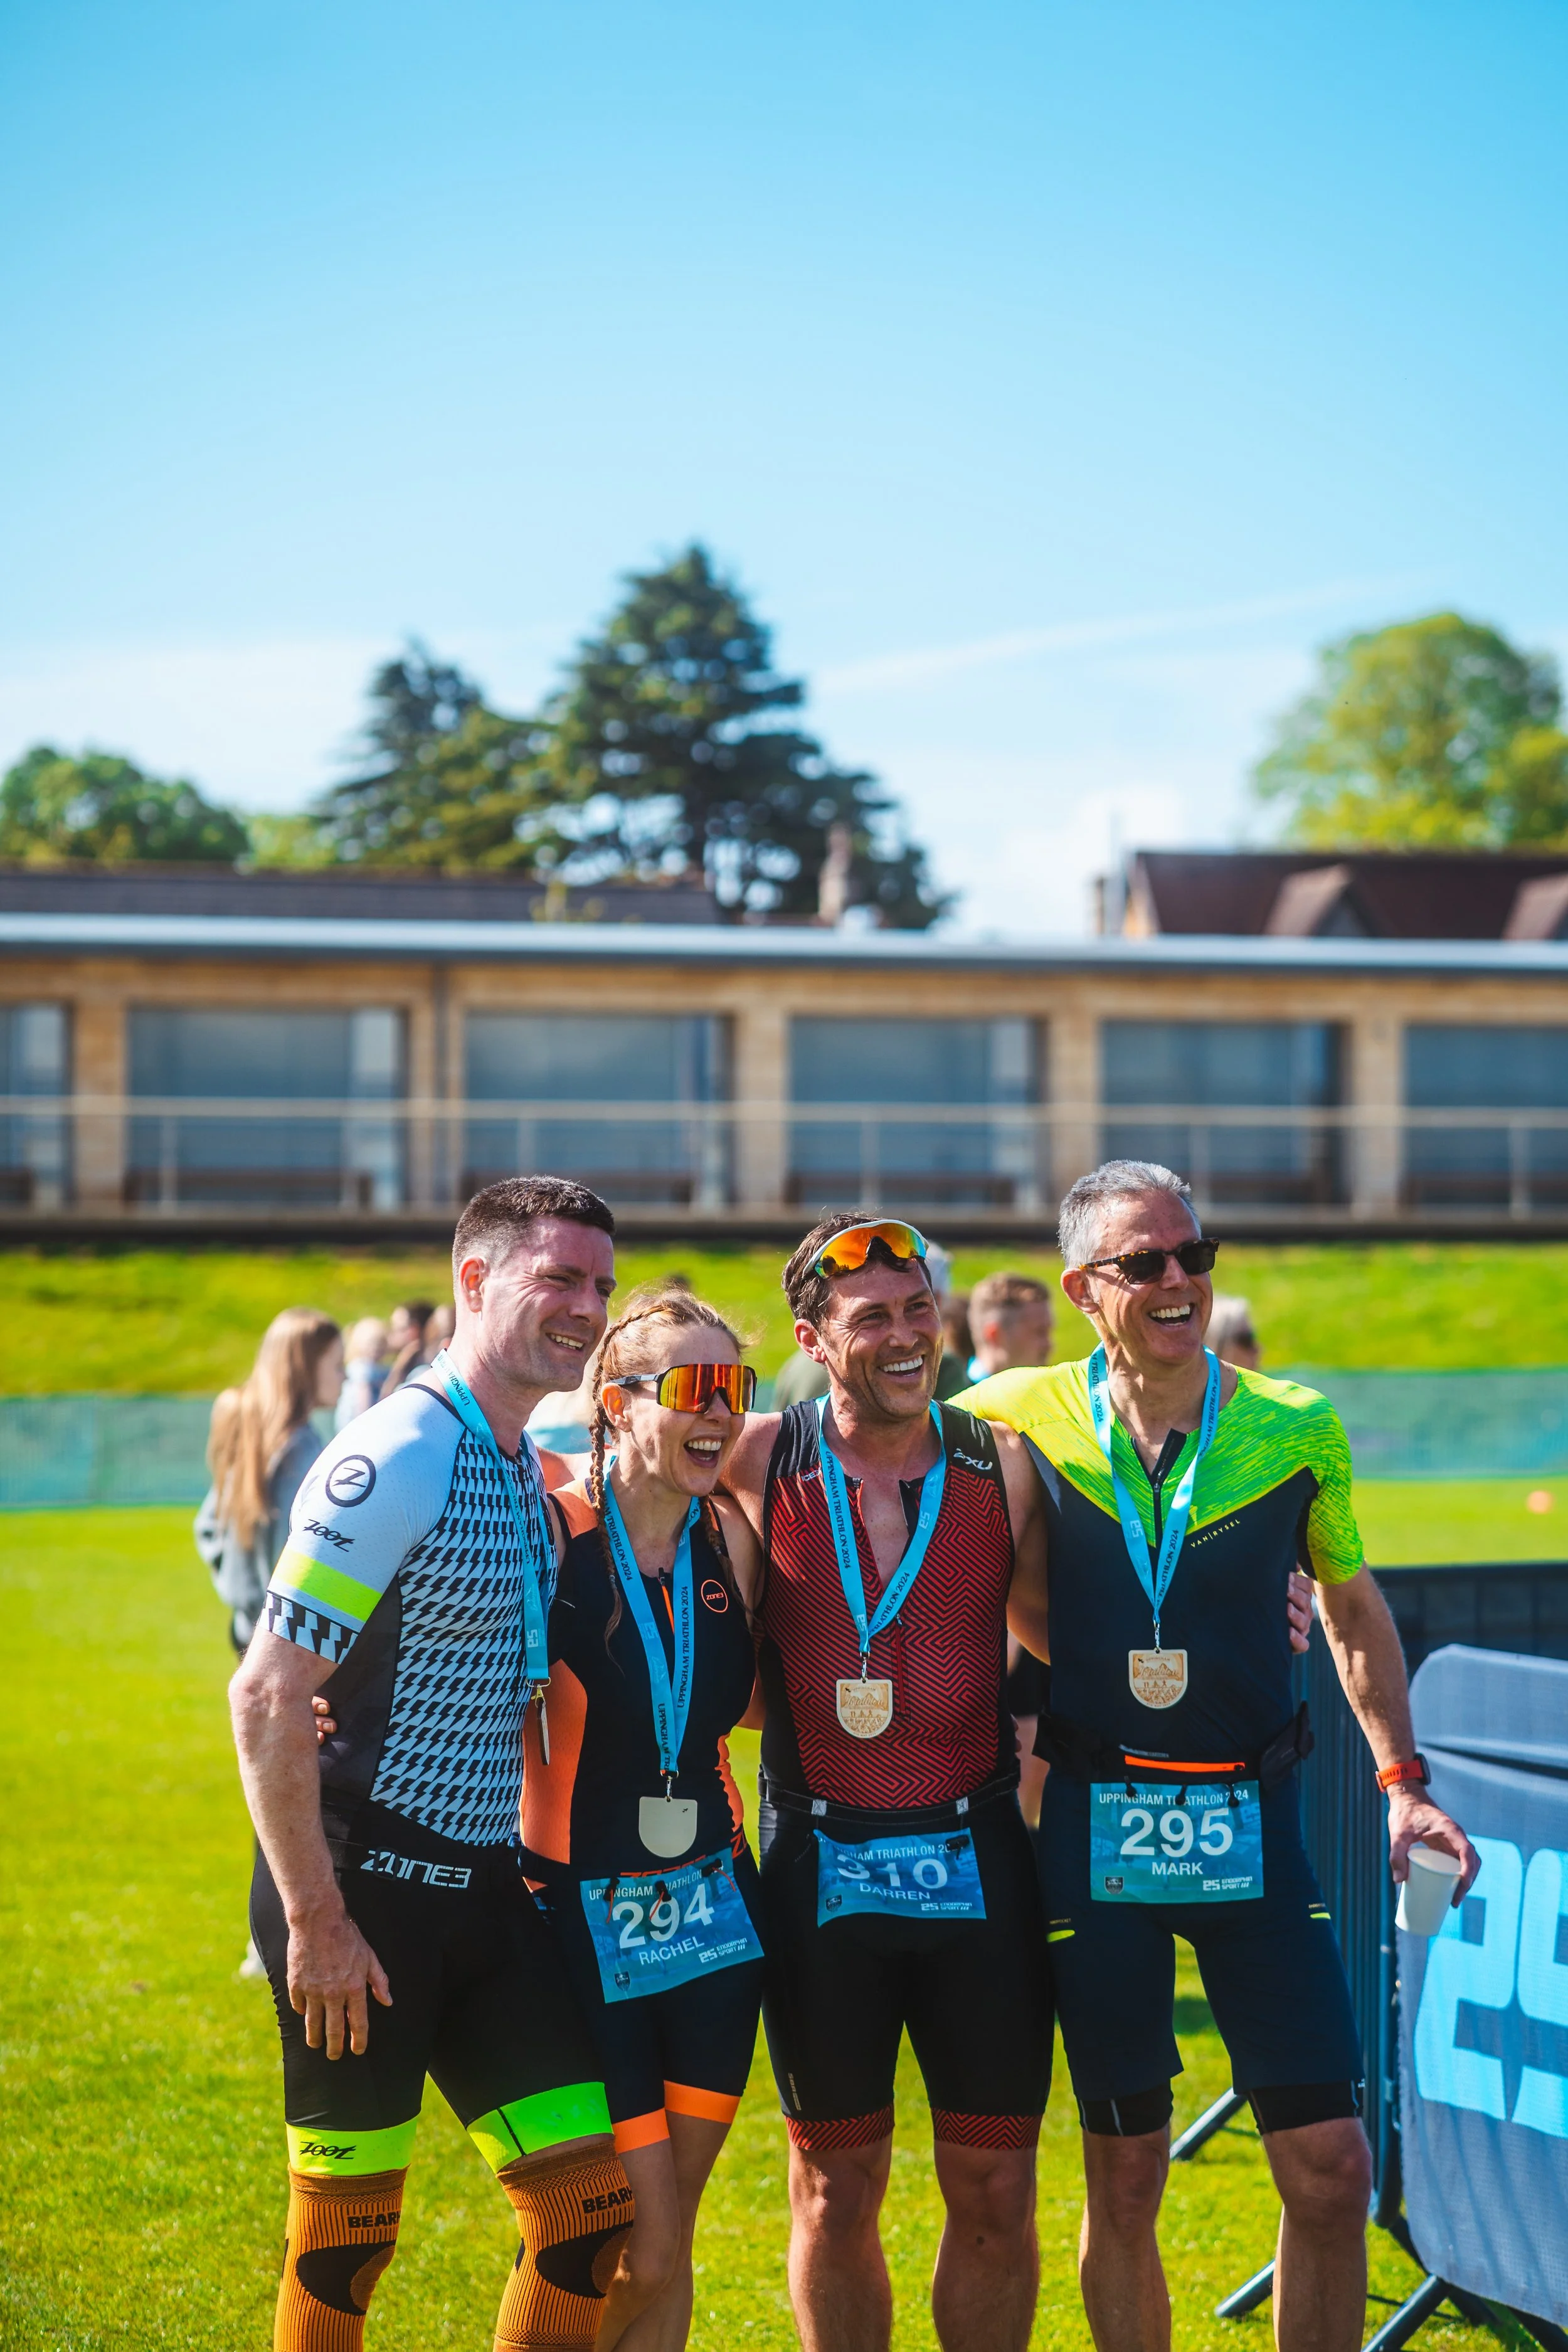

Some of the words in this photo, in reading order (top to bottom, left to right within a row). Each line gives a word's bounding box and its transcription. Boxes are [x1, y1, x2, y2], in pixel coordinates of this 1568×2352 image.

[825, 1451, 839, 1499] UPPINGHAM
[834, 1500, 847, 1547] TRIATHLON
[841, 1547, 852, 1569] 2024
[607, 1516, 627, 1562] TRIATHLON
[621, 1560, 633, 1581] 2024
[1170, 1530, 1179, 1550] 2024
[706, 1592, 724, 1601] ZONE3
[896, 1571, 910, 1592] 2024
[682, 1607, 690, 1654] TRIATHLON
[677, 1656, 689, 1708] UPPINGHAM
[1120, 1808, 1233, 1857] 295
[877, 1845, 935, 1859] TRIATHLON
[837, 1854, 948, 1888] 310
[1152, 1862, 1203, 1875] MARK
[860, 1883, 930, 1900] DARREN
[612, 1883, 715, 1949] 294
[638, 1936, 705, 1966] RACHEL
